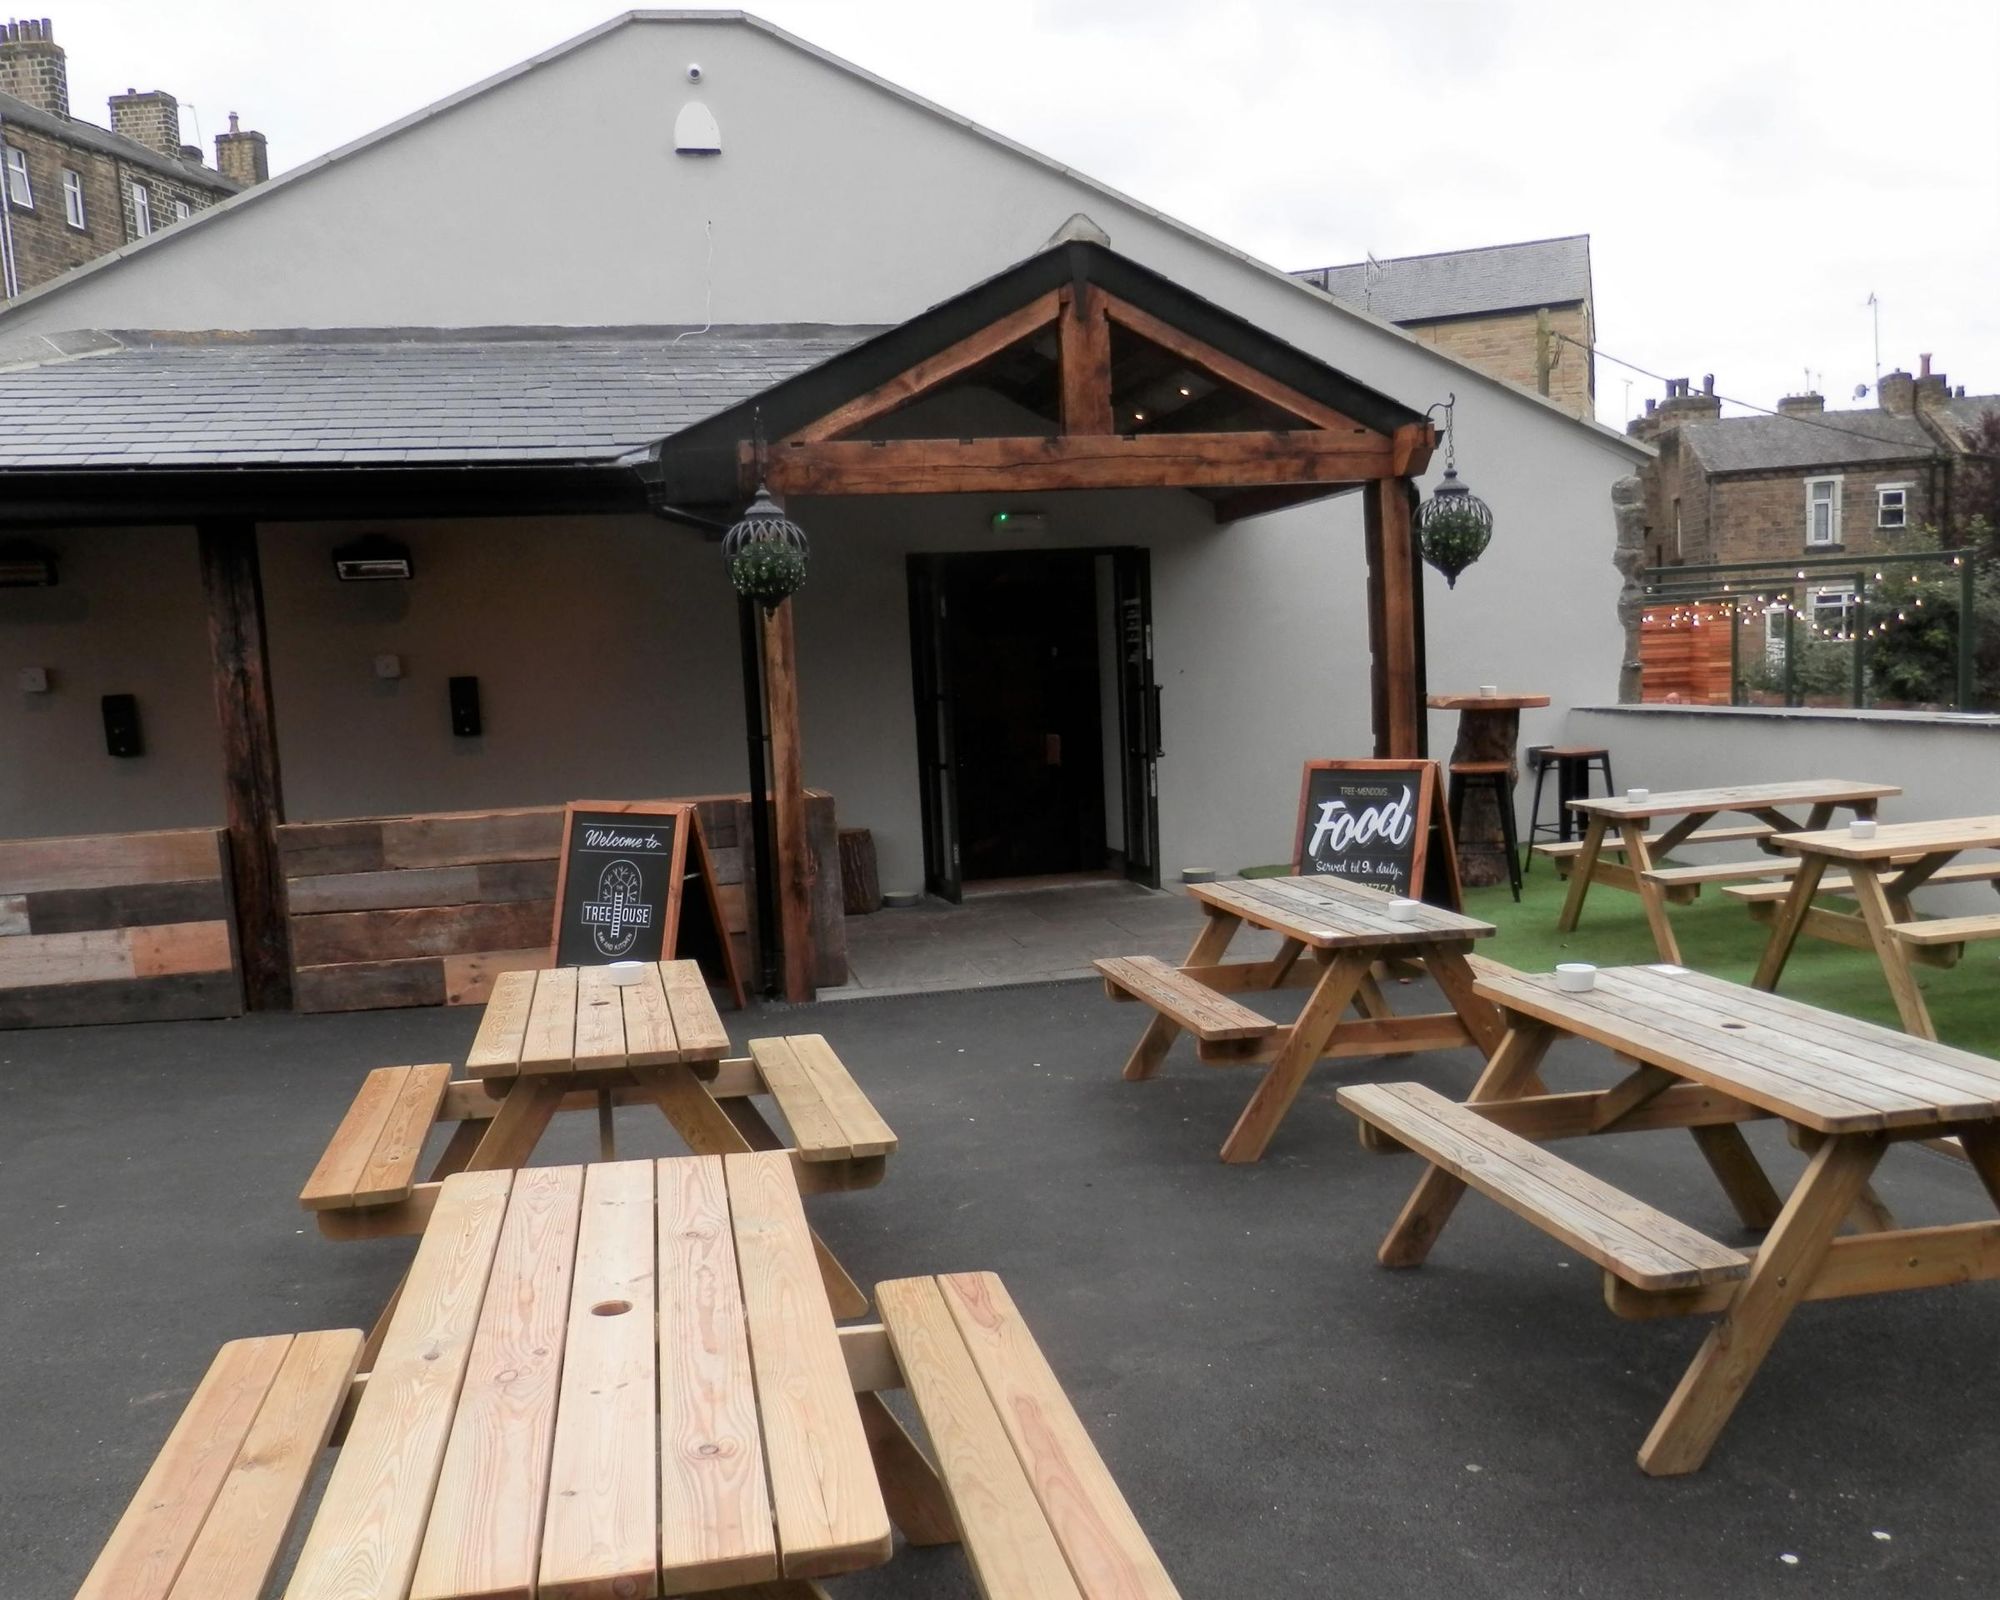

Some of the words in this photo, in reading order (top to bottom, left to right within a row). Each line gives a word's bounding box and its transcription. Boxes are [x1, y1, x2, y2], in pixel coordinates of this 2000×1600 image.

[1308, 784, 1412, 857] Food
[585, 829, 642, 848] Welcome
[644, 834, 662, 849] to
[1316, 859, 1347, 873] Served
[1375, 861, 1402, 880] daily
